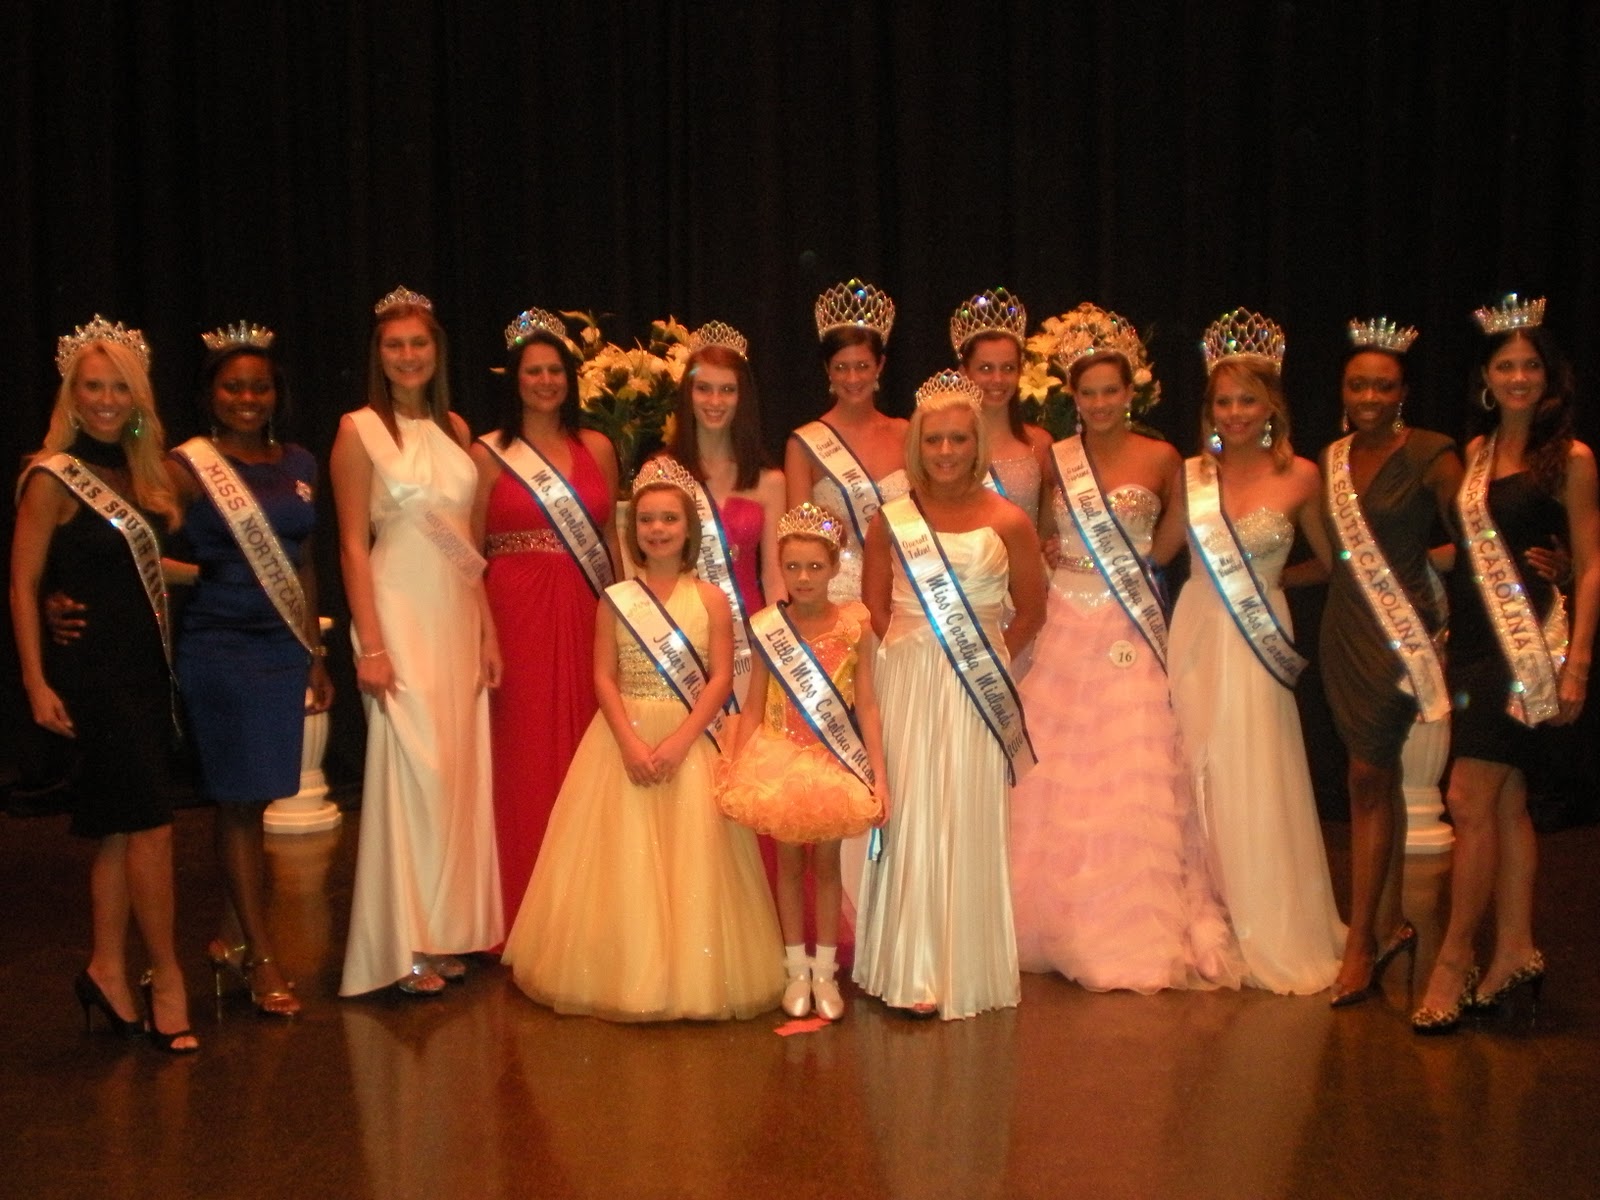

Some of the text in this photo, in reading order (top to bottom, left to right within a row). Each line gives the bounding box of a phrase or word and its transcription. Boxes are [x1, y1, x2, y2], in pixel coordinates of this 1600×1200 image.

[62, 464, 101, 503] MRS.
[104, 501, 153, 556] SOUTH
[204, 462, 248, 511] MISS
[240, 512, 288, 588] NORTH
[531, 469, 552, 497] Ms.
[554, 496, 588, 547] Carolina
[842, 468, 865, 499] Miss
[701, 534, 721, 587] Carolina
[1077, 488, 1102, 520] Ideal
[1091, 521, 1115, 553] Miss
[1111, 554, 1143, 606] Carolina
[1333, 480, 1365, 547] SOUTH
[1360, 551, 1423, 655] CAROLINA
[1239, 595, 1265, 630] Miss
[1479, 539, 1531, 650] CAROLINA
[653, 632, 687, 674] Junior
[766, 627, 794, 666] Little
[790, 662, 818, 698] Miss
[816, 698, 851, 753] Carolina
[925, 573, 1013, 731] Miss Carolina Midlands
[1118, 650, 1133, 664] 16
[1007, 732, 1024, 759] 2010
